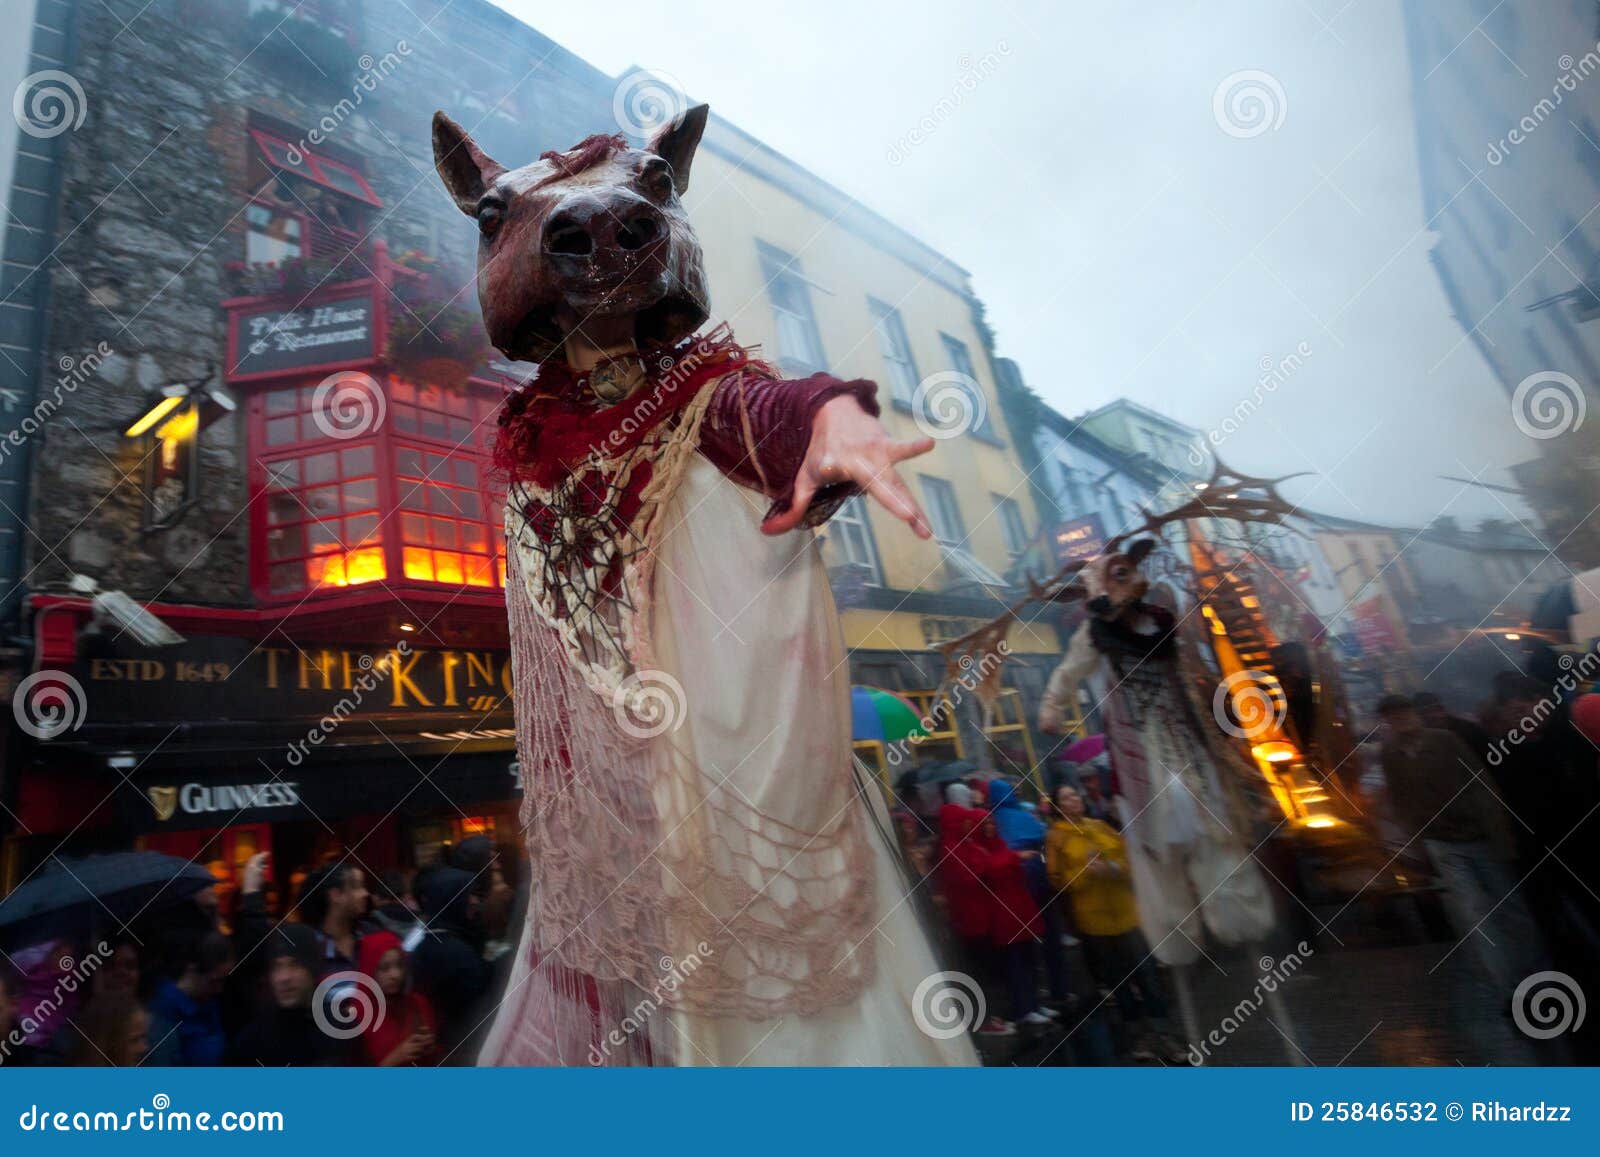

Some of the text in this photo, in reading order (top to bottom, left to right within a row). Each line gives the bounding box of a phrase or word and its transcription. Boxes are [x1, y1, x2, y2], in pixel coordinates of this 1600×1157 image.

[91, 659, 165, 681] ESTD
[175, 661, 229, 682] 1649
[180, 782, 301, 814] GUINNESS
